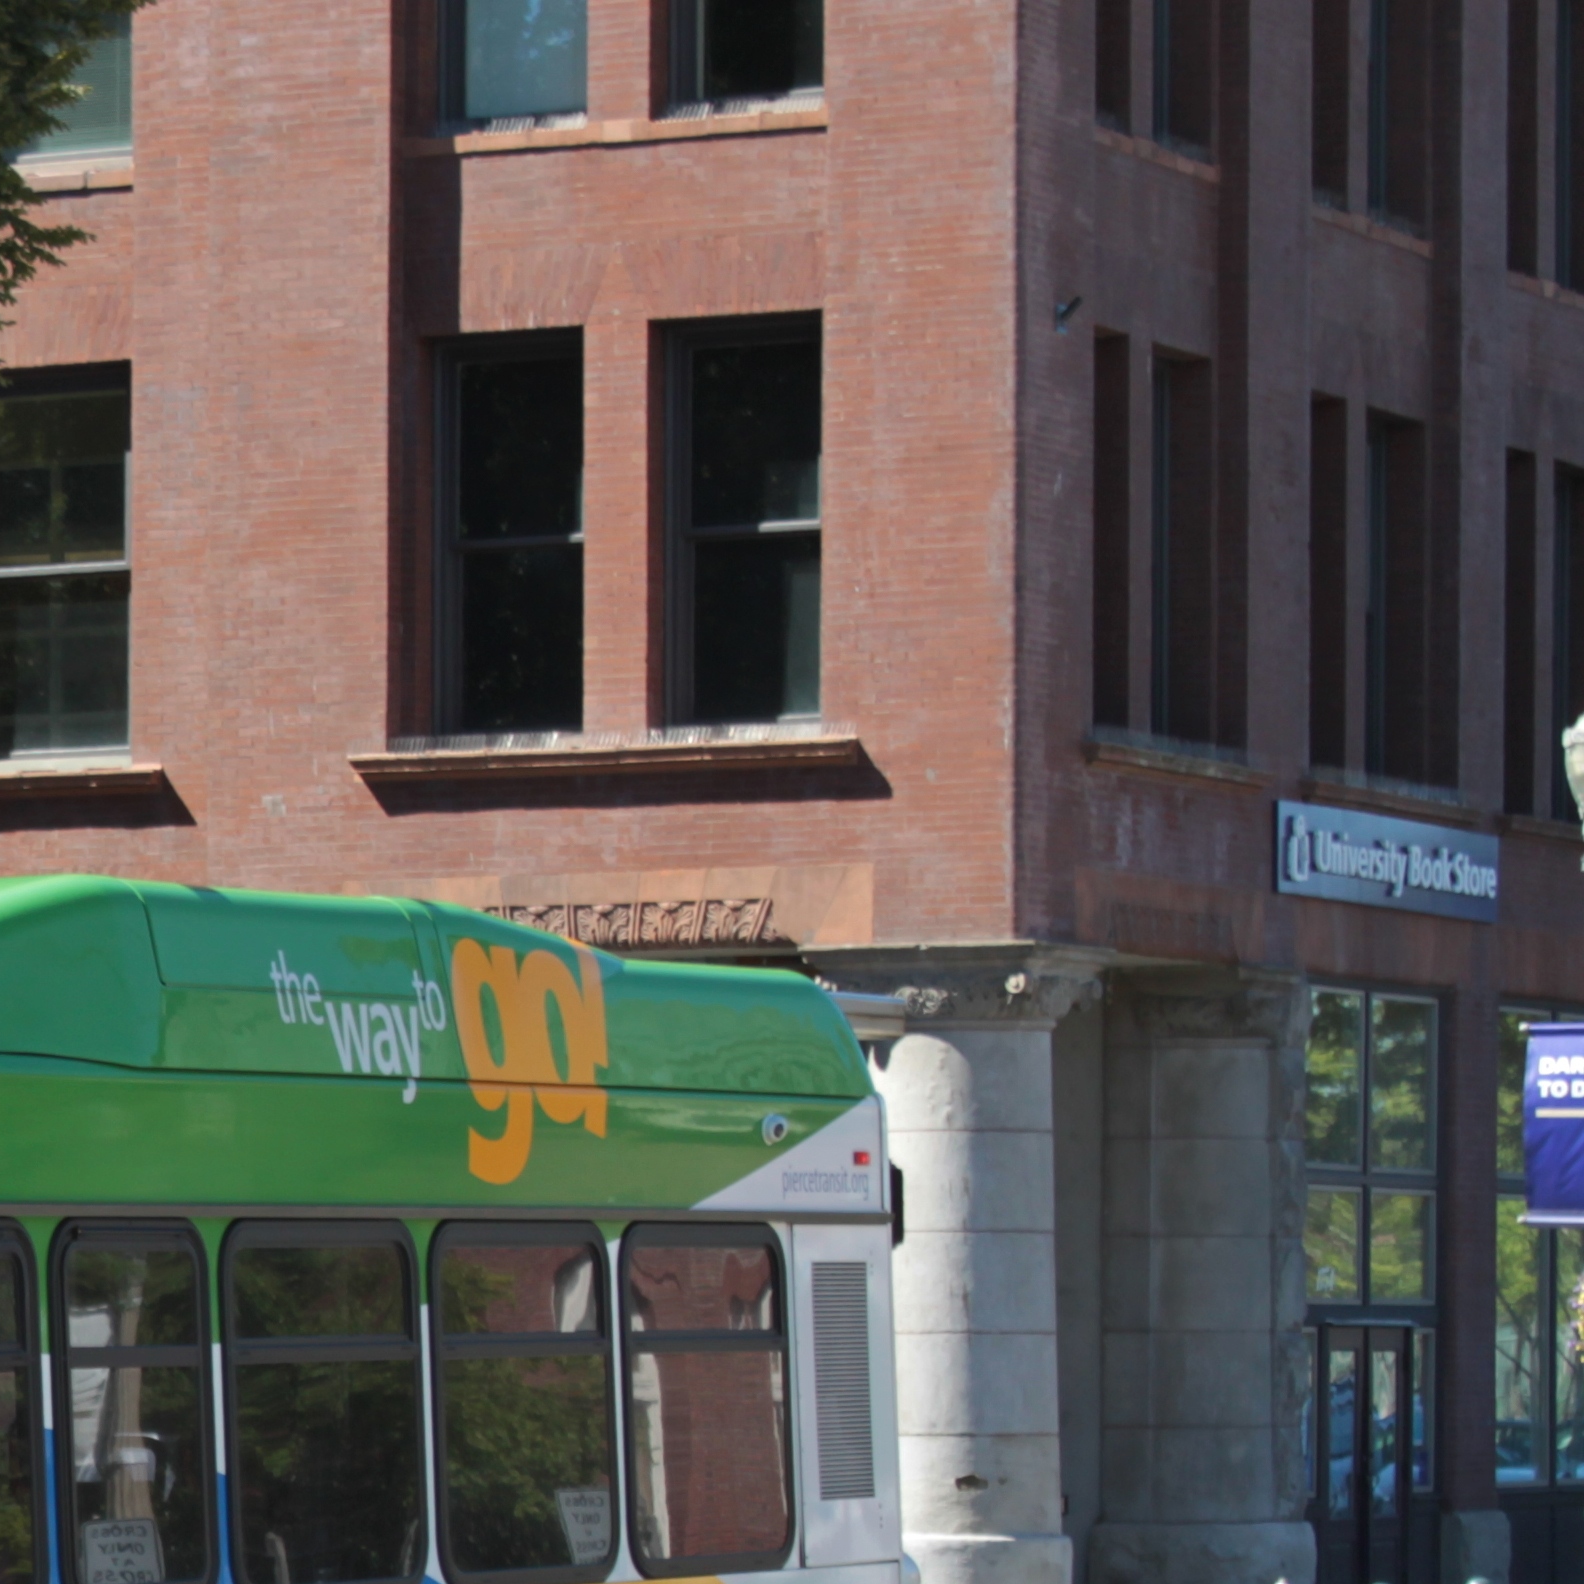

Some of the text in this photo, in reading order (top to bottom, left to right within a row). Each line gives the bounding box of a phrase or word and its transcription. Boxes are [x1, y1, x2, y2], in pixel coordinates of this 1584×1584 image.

[1313, 830, 1408, 898] University
[270, 949, 325, 1026] the
[325, 1001, 422, 1104] way
[412, 969, 447, 1032] to
[1537, 1080, 1568, 1099] TO
[782, 1164, 869, 1201] piercetransit.org
